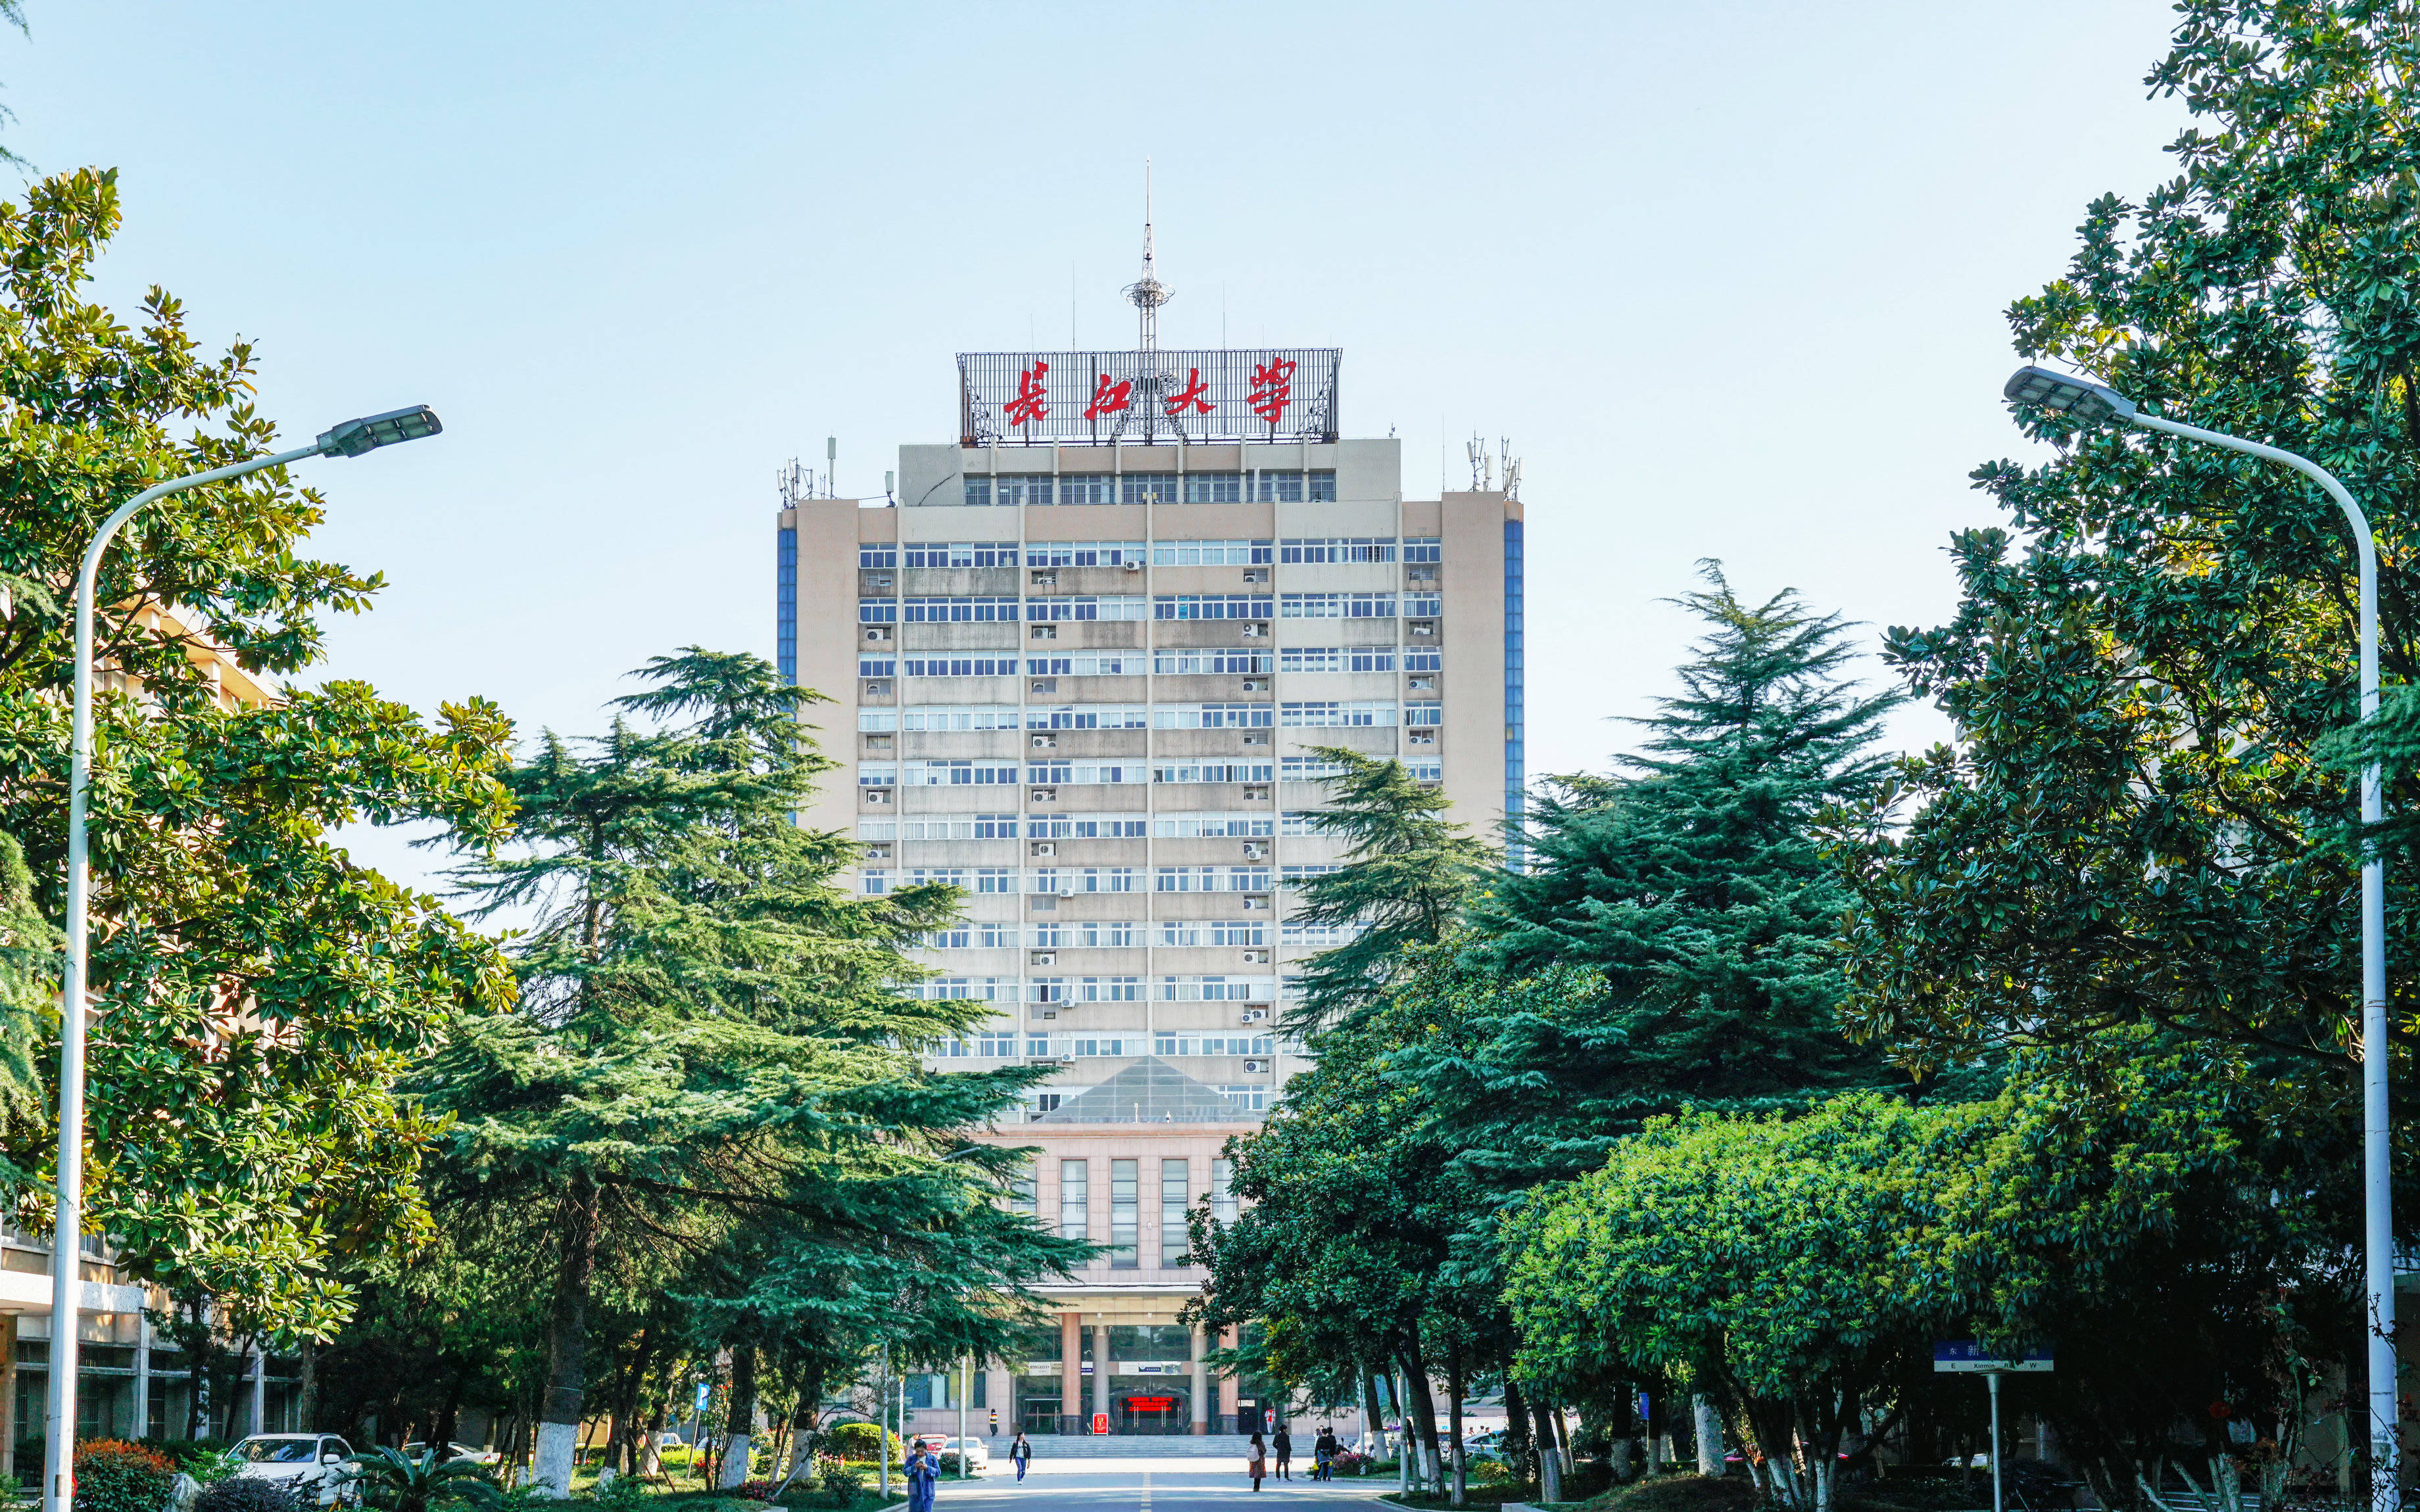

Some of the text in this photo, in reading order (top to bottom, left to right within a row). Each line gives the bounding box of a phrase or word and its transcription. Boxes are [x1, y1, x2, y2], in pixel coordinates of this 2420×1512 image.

[1004, 357, 1296, 426] 长江大学
[698, 1386, 708, 1406] P
